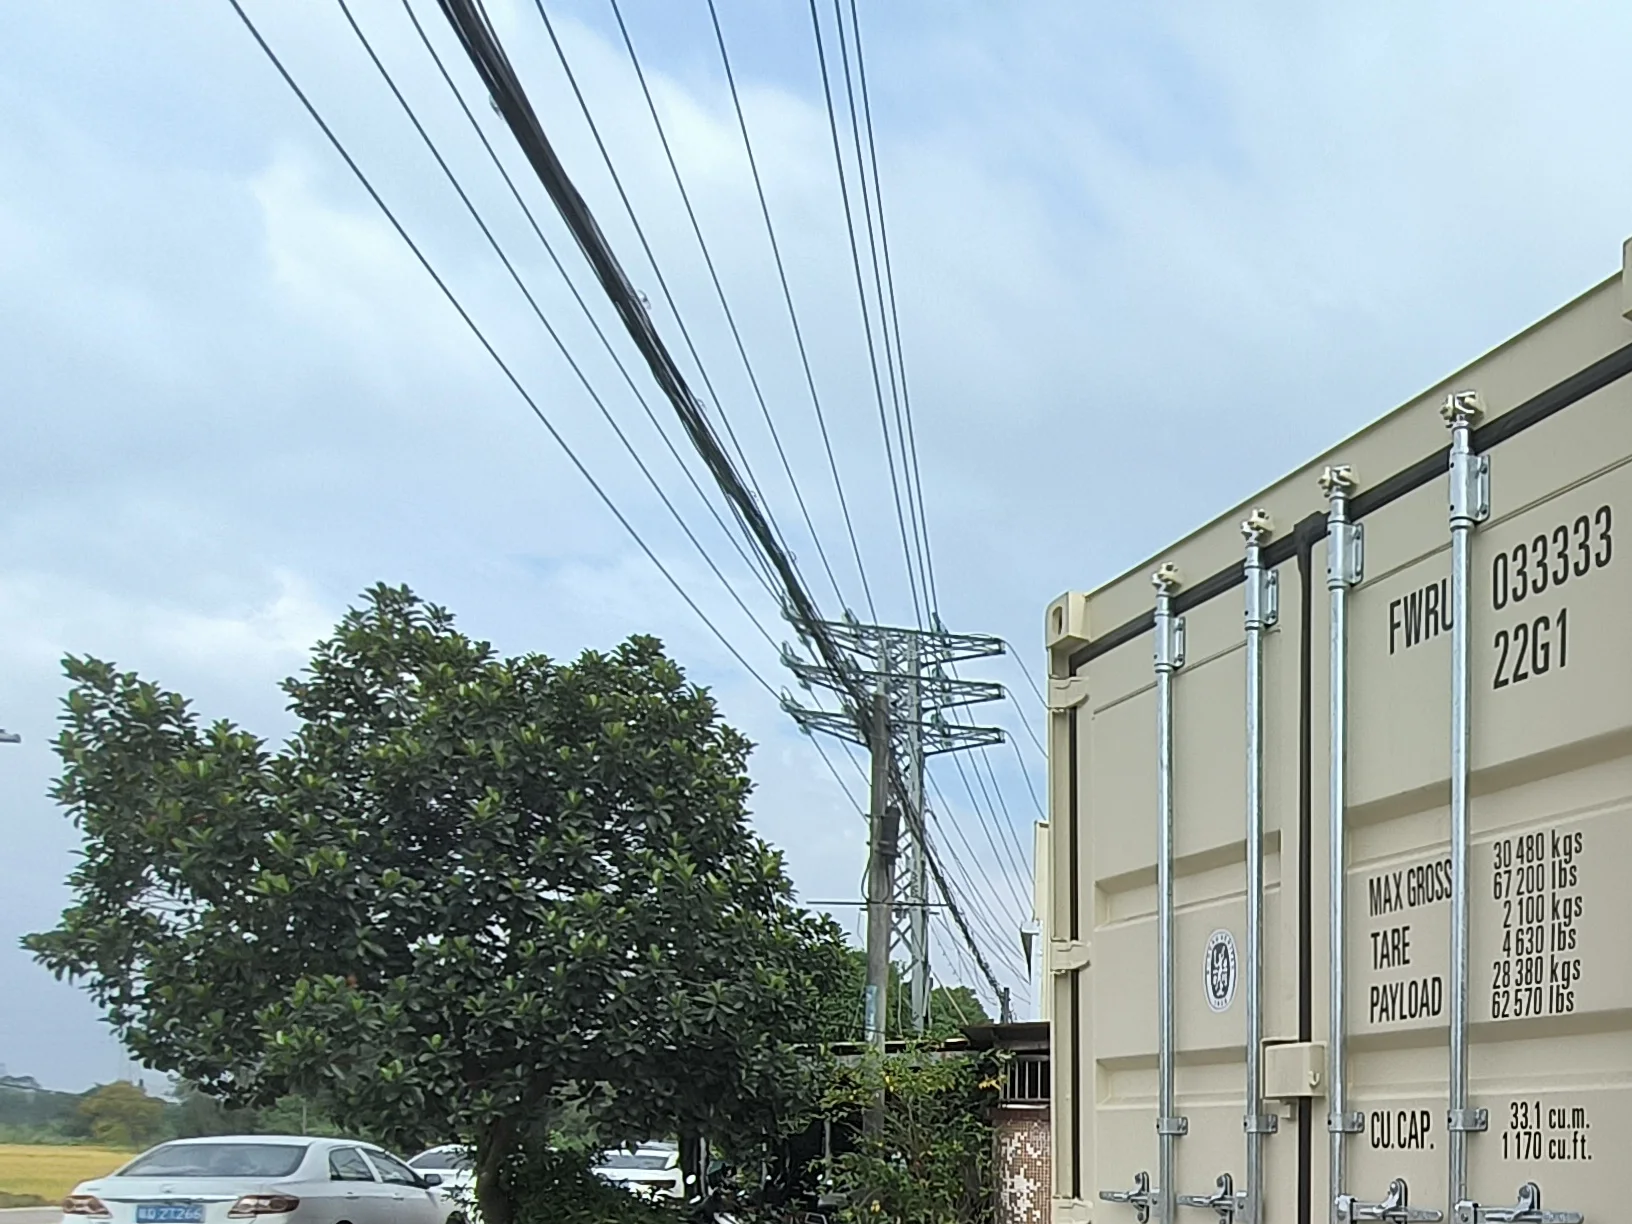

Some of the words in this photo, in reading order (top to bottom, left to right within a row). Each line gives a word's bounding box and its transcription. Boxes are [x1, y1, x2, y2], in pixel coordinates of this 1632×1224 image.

[1492, 505, 1613, 611] 033333
[1492, 608, 1568, 690] 22G1
[1493, 840, 1512, 870] 30
[1516, 832, 1545, 864] 480
[1552, 828, 1583, 864] kgs
[1369, 869, 1403, 917] MAX
[1407, 858, 1452, 909] GROSS
[1493, 871, 1511, 900] 67
[1516, 863, 1545, 896] 200
[1551, 860, 1578, 889] lbs
[1503, 900, 1512, 928] 2
[1517, 895, 1545, 926] 100
[1551, 892, 1583, 927] kgs
[1371, 926, 1411, 970] TARE
[1502, 931, 1511, 957] 4
[1516, 925, 1544, 956] 630
[1551, 924, 1577, 951] lbs
[1493, 961, 1511, 989] 28
[1514, 956, 1543, 987] 380
[1550, 954, 1581, 989] kgs
[1370, 976, 1443, 1023] PAYLOAD
[1491, 991, 1510, 1018] 62
[1513, 986, 1543, 1016] 570
[1549, 985, 1574, 1013] lbs
[1510, 1101, 1541, 1130] 33.1
[1548, 1106, 1591, 1129] cu.m.
[1515, 1131, 1542, 1160] 170
[1548, 1131, 1592, 1160] cu.ft.
